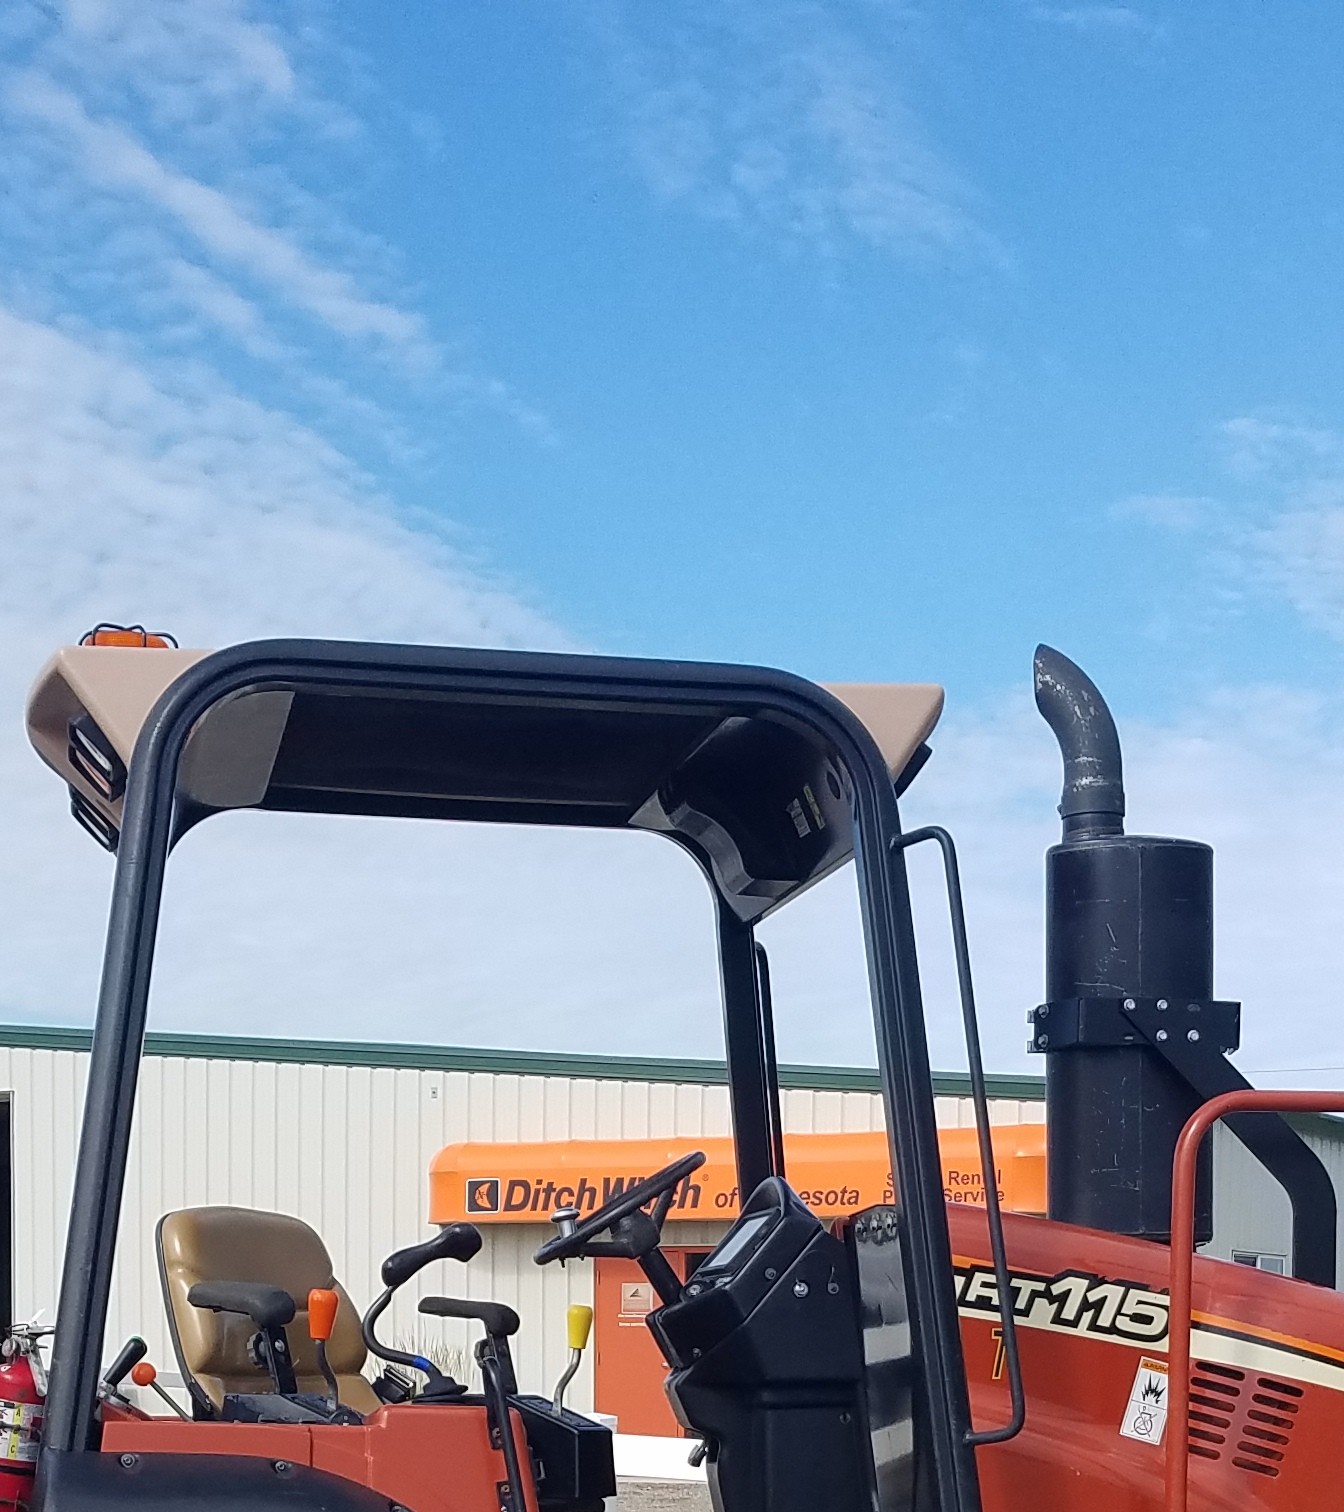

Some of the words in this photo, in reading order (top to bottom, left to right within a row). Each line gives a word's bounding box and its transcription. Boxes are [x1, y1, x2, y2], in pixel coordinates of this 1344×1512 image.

[948, 1168, 1001, 1186] Renl
[503, 1177, 598, 1212] Ditch
[715, 1186, 739, 1208] of
[798, 1185, 860, 1206] esota
[943, 1187, 1005, 1202] Servie
